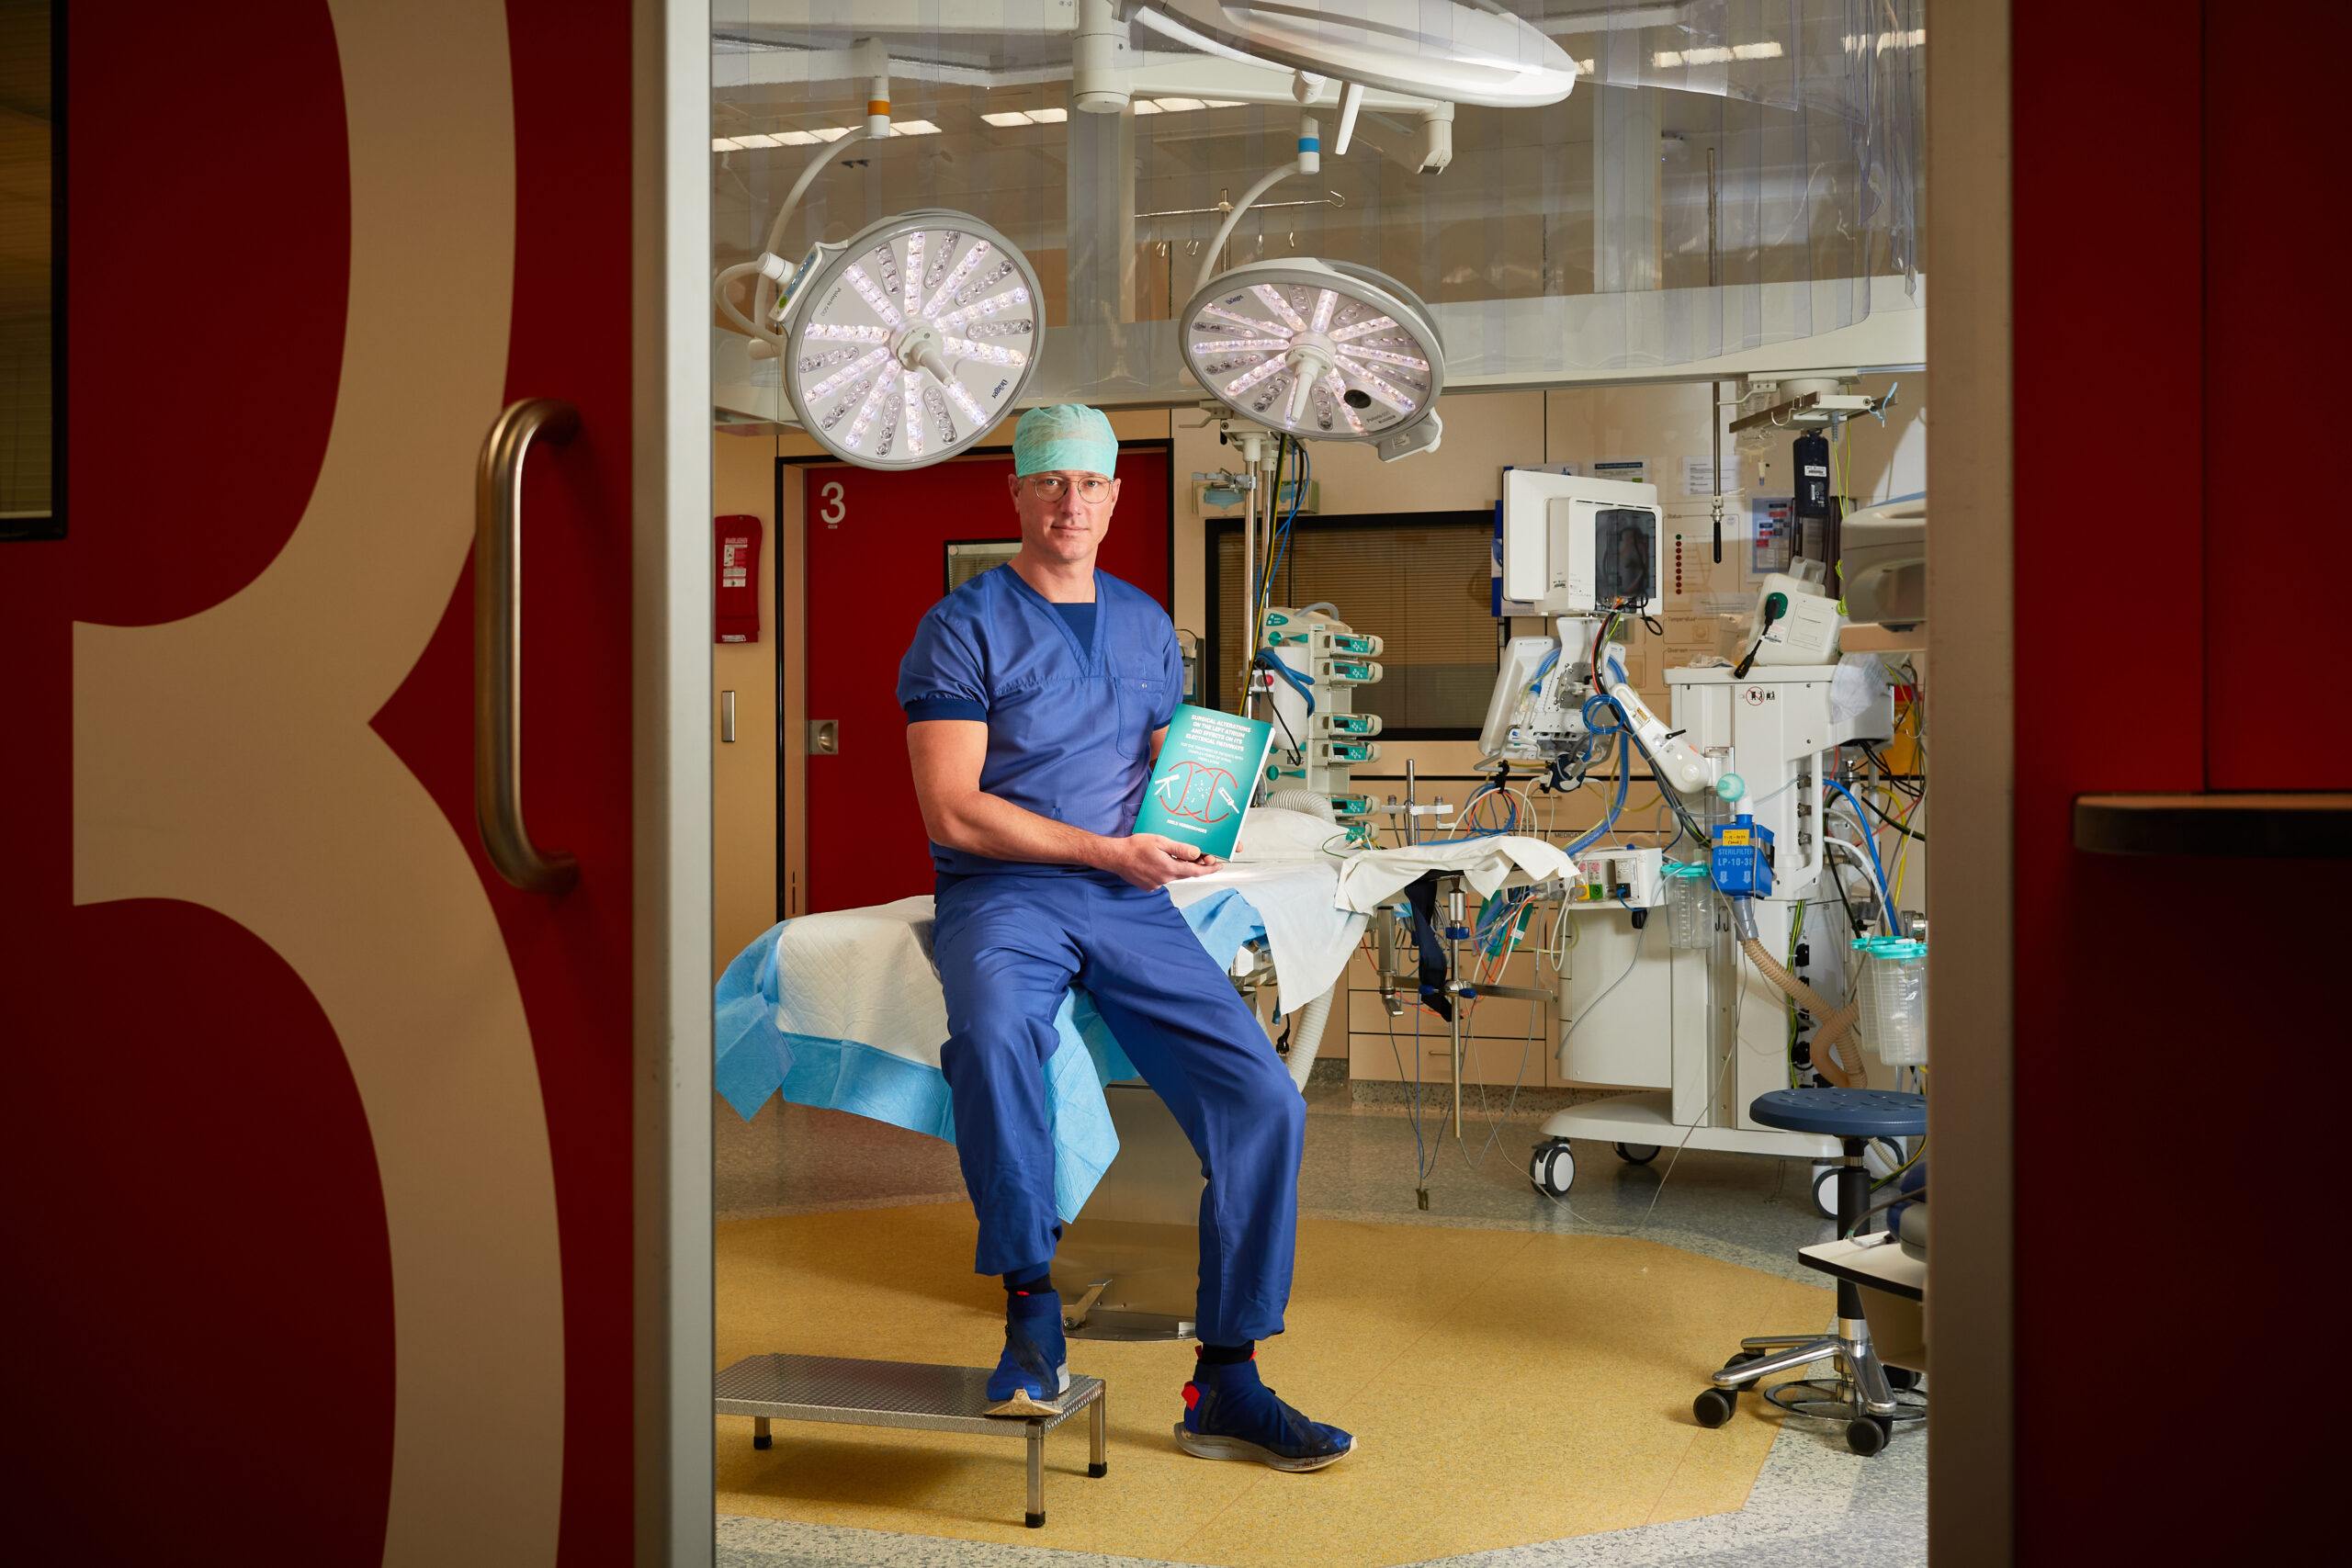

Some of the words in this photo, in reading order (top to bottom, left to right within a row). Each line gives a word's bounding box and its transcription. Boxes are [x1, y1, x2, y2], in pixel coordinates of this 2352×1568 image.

[820, 481, 845, 524] 3
[1191, 715, 1216, 725] SURGICAL
[1216, 720, 1251, 733] ALTERATIONS
[1225, 728, 1245, 738] ATRIUM
[1185, 733, 1216, 745] ELECTRICAL
[1216, 740, 1244, 751] PATHWAYS
[1203, 730, 1225, 740] EFFECTS
